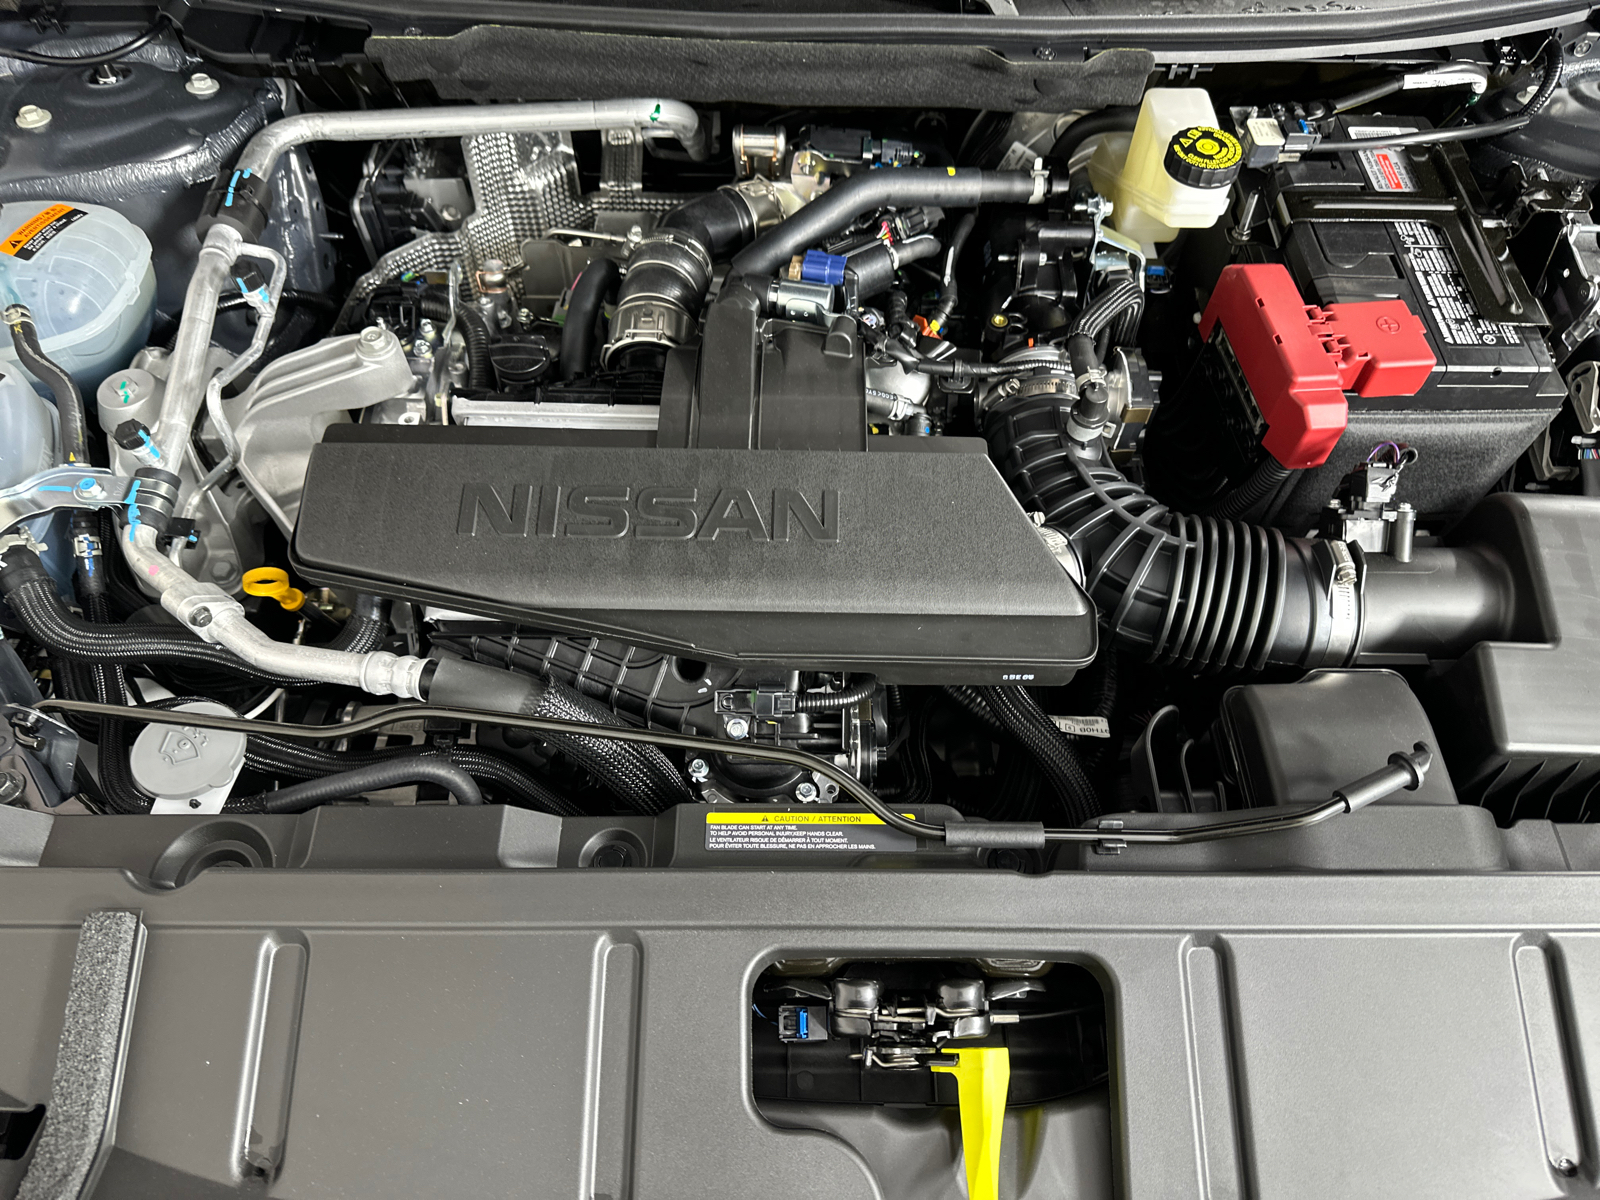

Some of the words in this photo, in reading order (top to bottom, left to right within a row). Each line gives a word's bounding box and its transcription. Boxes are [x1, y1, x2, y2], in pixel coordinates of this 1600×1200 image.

[457, 483, 840, 543] NISSAN
[774, 815, 809, 823] CAUTION
[818, 815, 861, 823] ATTENTION
